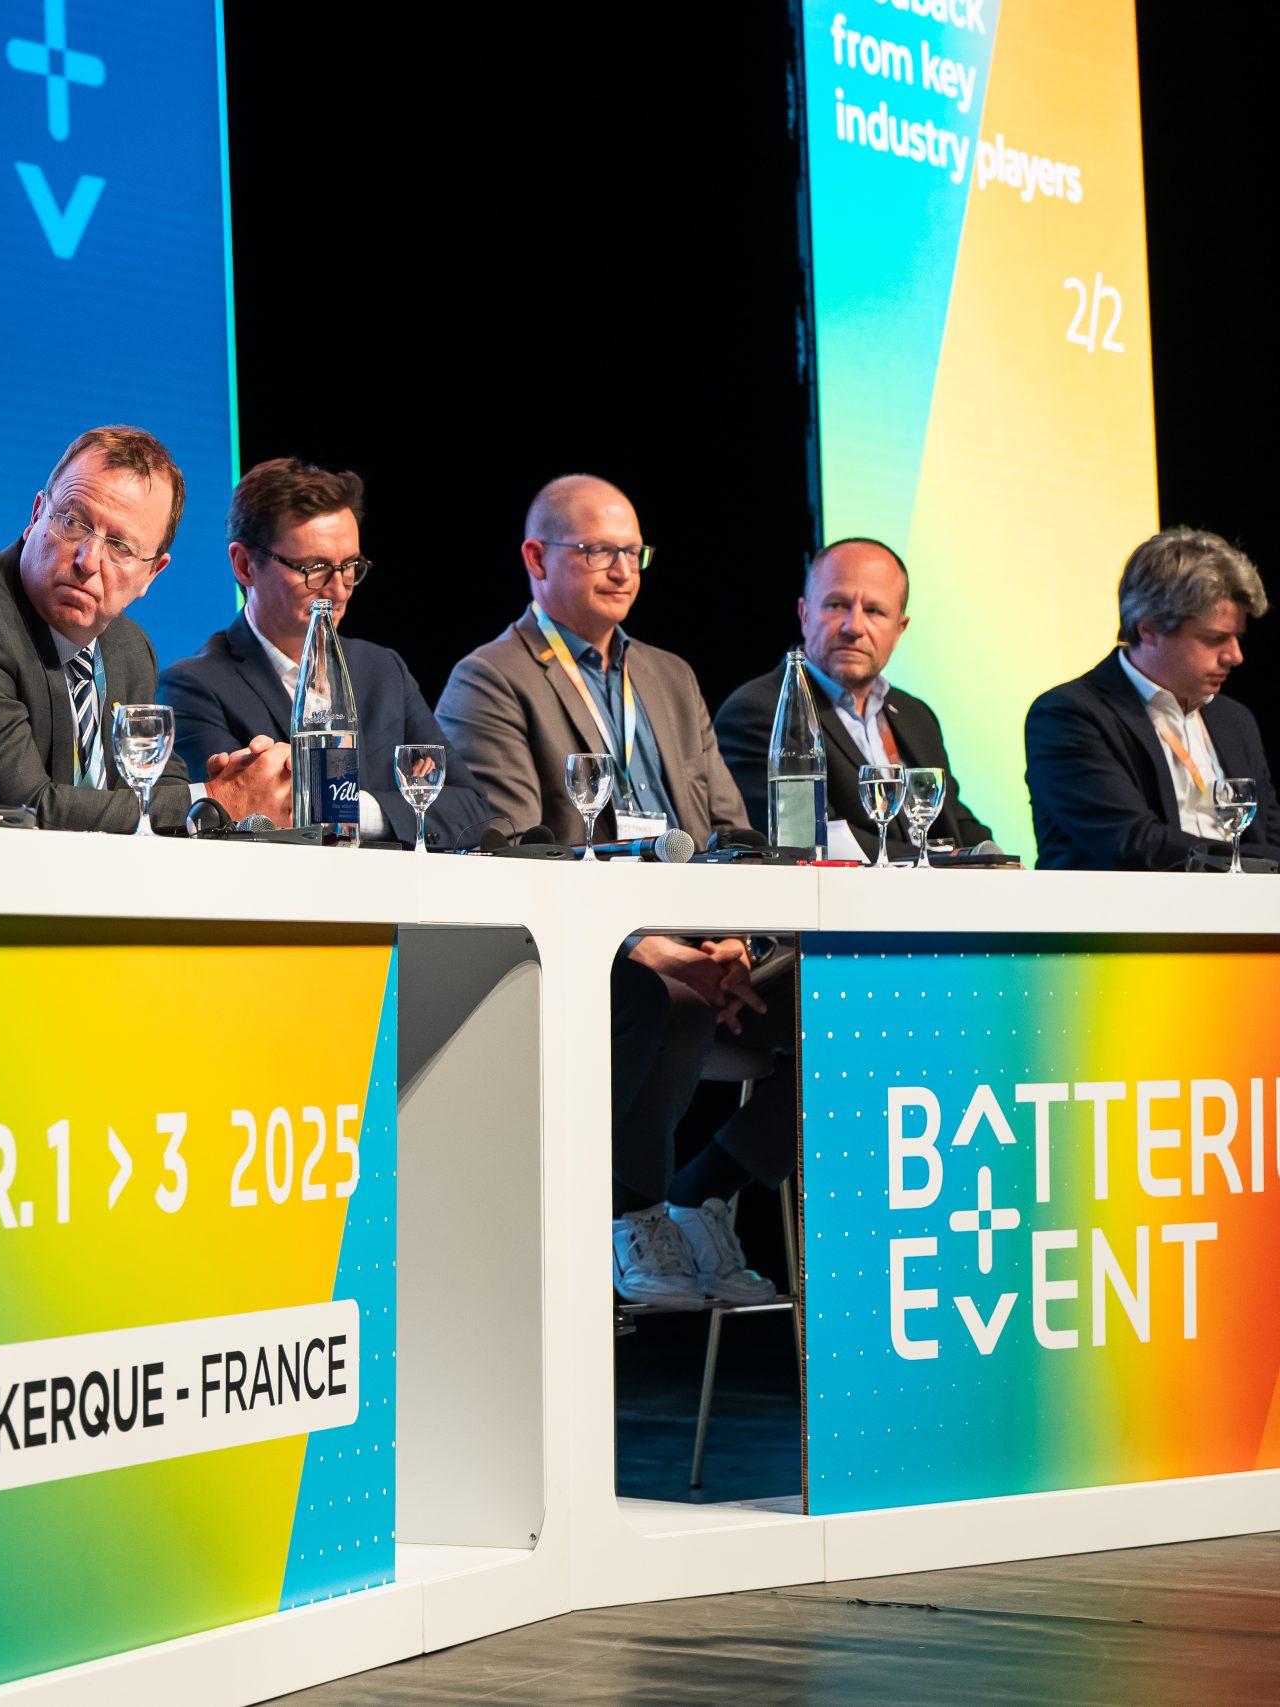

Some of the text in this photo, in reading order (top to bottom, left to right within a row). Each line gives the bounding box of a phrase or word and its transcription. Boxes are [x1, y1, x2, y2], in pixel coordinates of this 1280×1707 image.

[830, 13, 976, 113] from key
[835, 87, 1084, 203] industry players
[1063, 271, 1125, 354] 2/2
[155, 1112, 188, 1214] 3
[230, 1103, 361, 1208] 2025
[887, 1077, 1280, 1210] BATTERI
[889, 1222, 1218, 1361] EVENT
[202, 1334, 348, 1418] FRANCE
